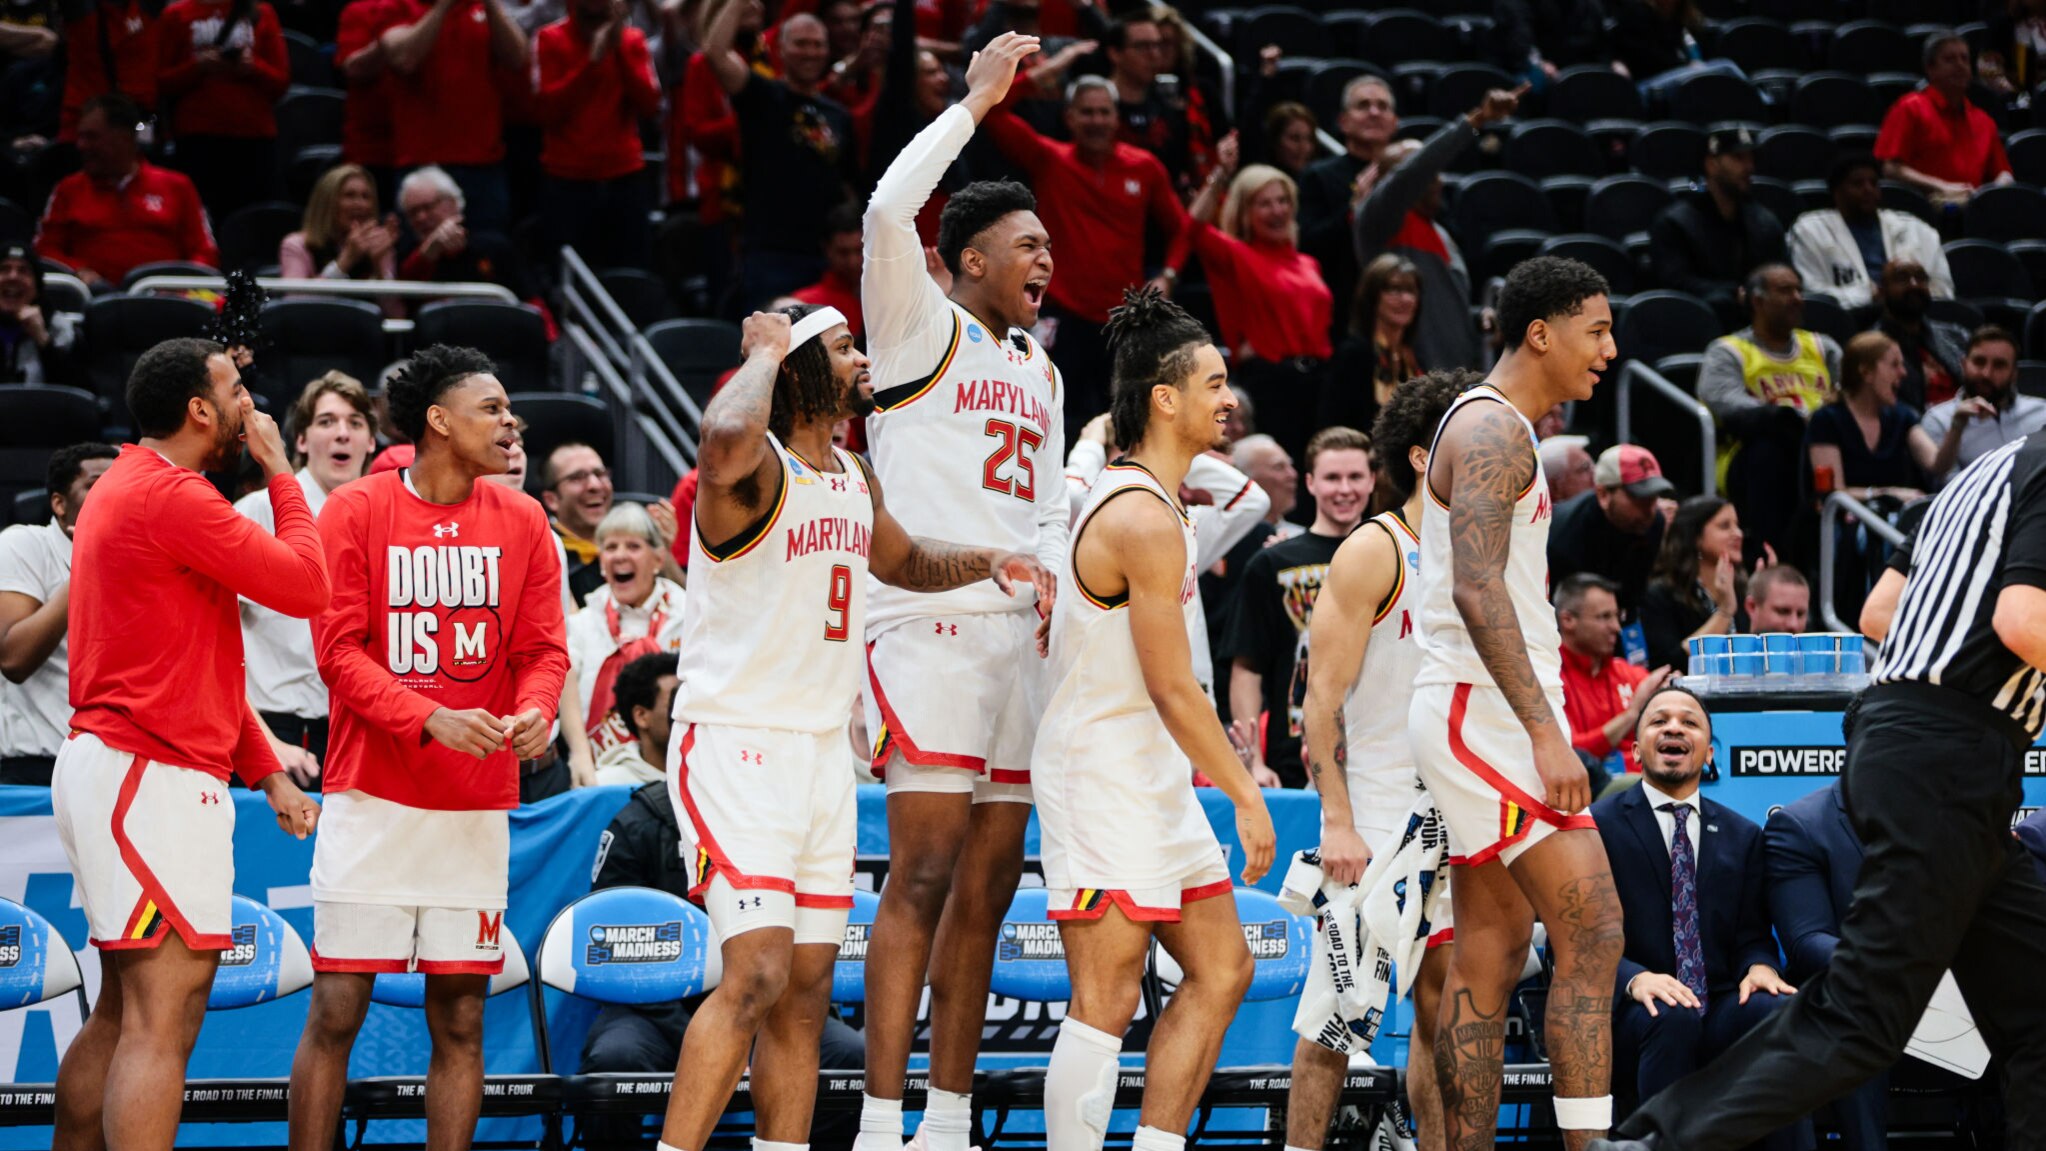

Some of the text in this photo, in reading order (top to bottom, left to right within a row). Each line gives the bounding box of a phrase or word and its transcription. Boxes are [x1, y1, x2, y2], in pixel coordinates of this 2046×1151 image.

[983, 418, 1044, 502] 25
[388, 545, 502, 609] DOUBT
[824, 564, 851, 642] 9
[388, 611, 439, 675] US
[453, 621, 488, 660] M
[476, 911, 502, 945] M
[606, 927, 655, 942] MARCH
[1328, 923, 1344, 951] ROAD
[613, 940, 681, 957] MADNESS
[1340, 969, 1355, 990] THE
[616, 1083, 634, 1093] THE
[636, 1082, 661, 1093] ROAD
[830, 1080, 847, 1090] THE
[1250, 1079, 1267, 1089] THE
[1503, 1074, 1520, 1084] THE
[1521, 1074, 1546, 1084] FINAL
[15, 1093, 33, 1105] THE
[193, 1090, 219, 1101] ROAD
[221, 1089, 234, 1100] TO
[236, 1089, 255, 1100] THE
[256, 1089, 283, 1100] FINAL
[397, 1085, 415, 1096] THE
